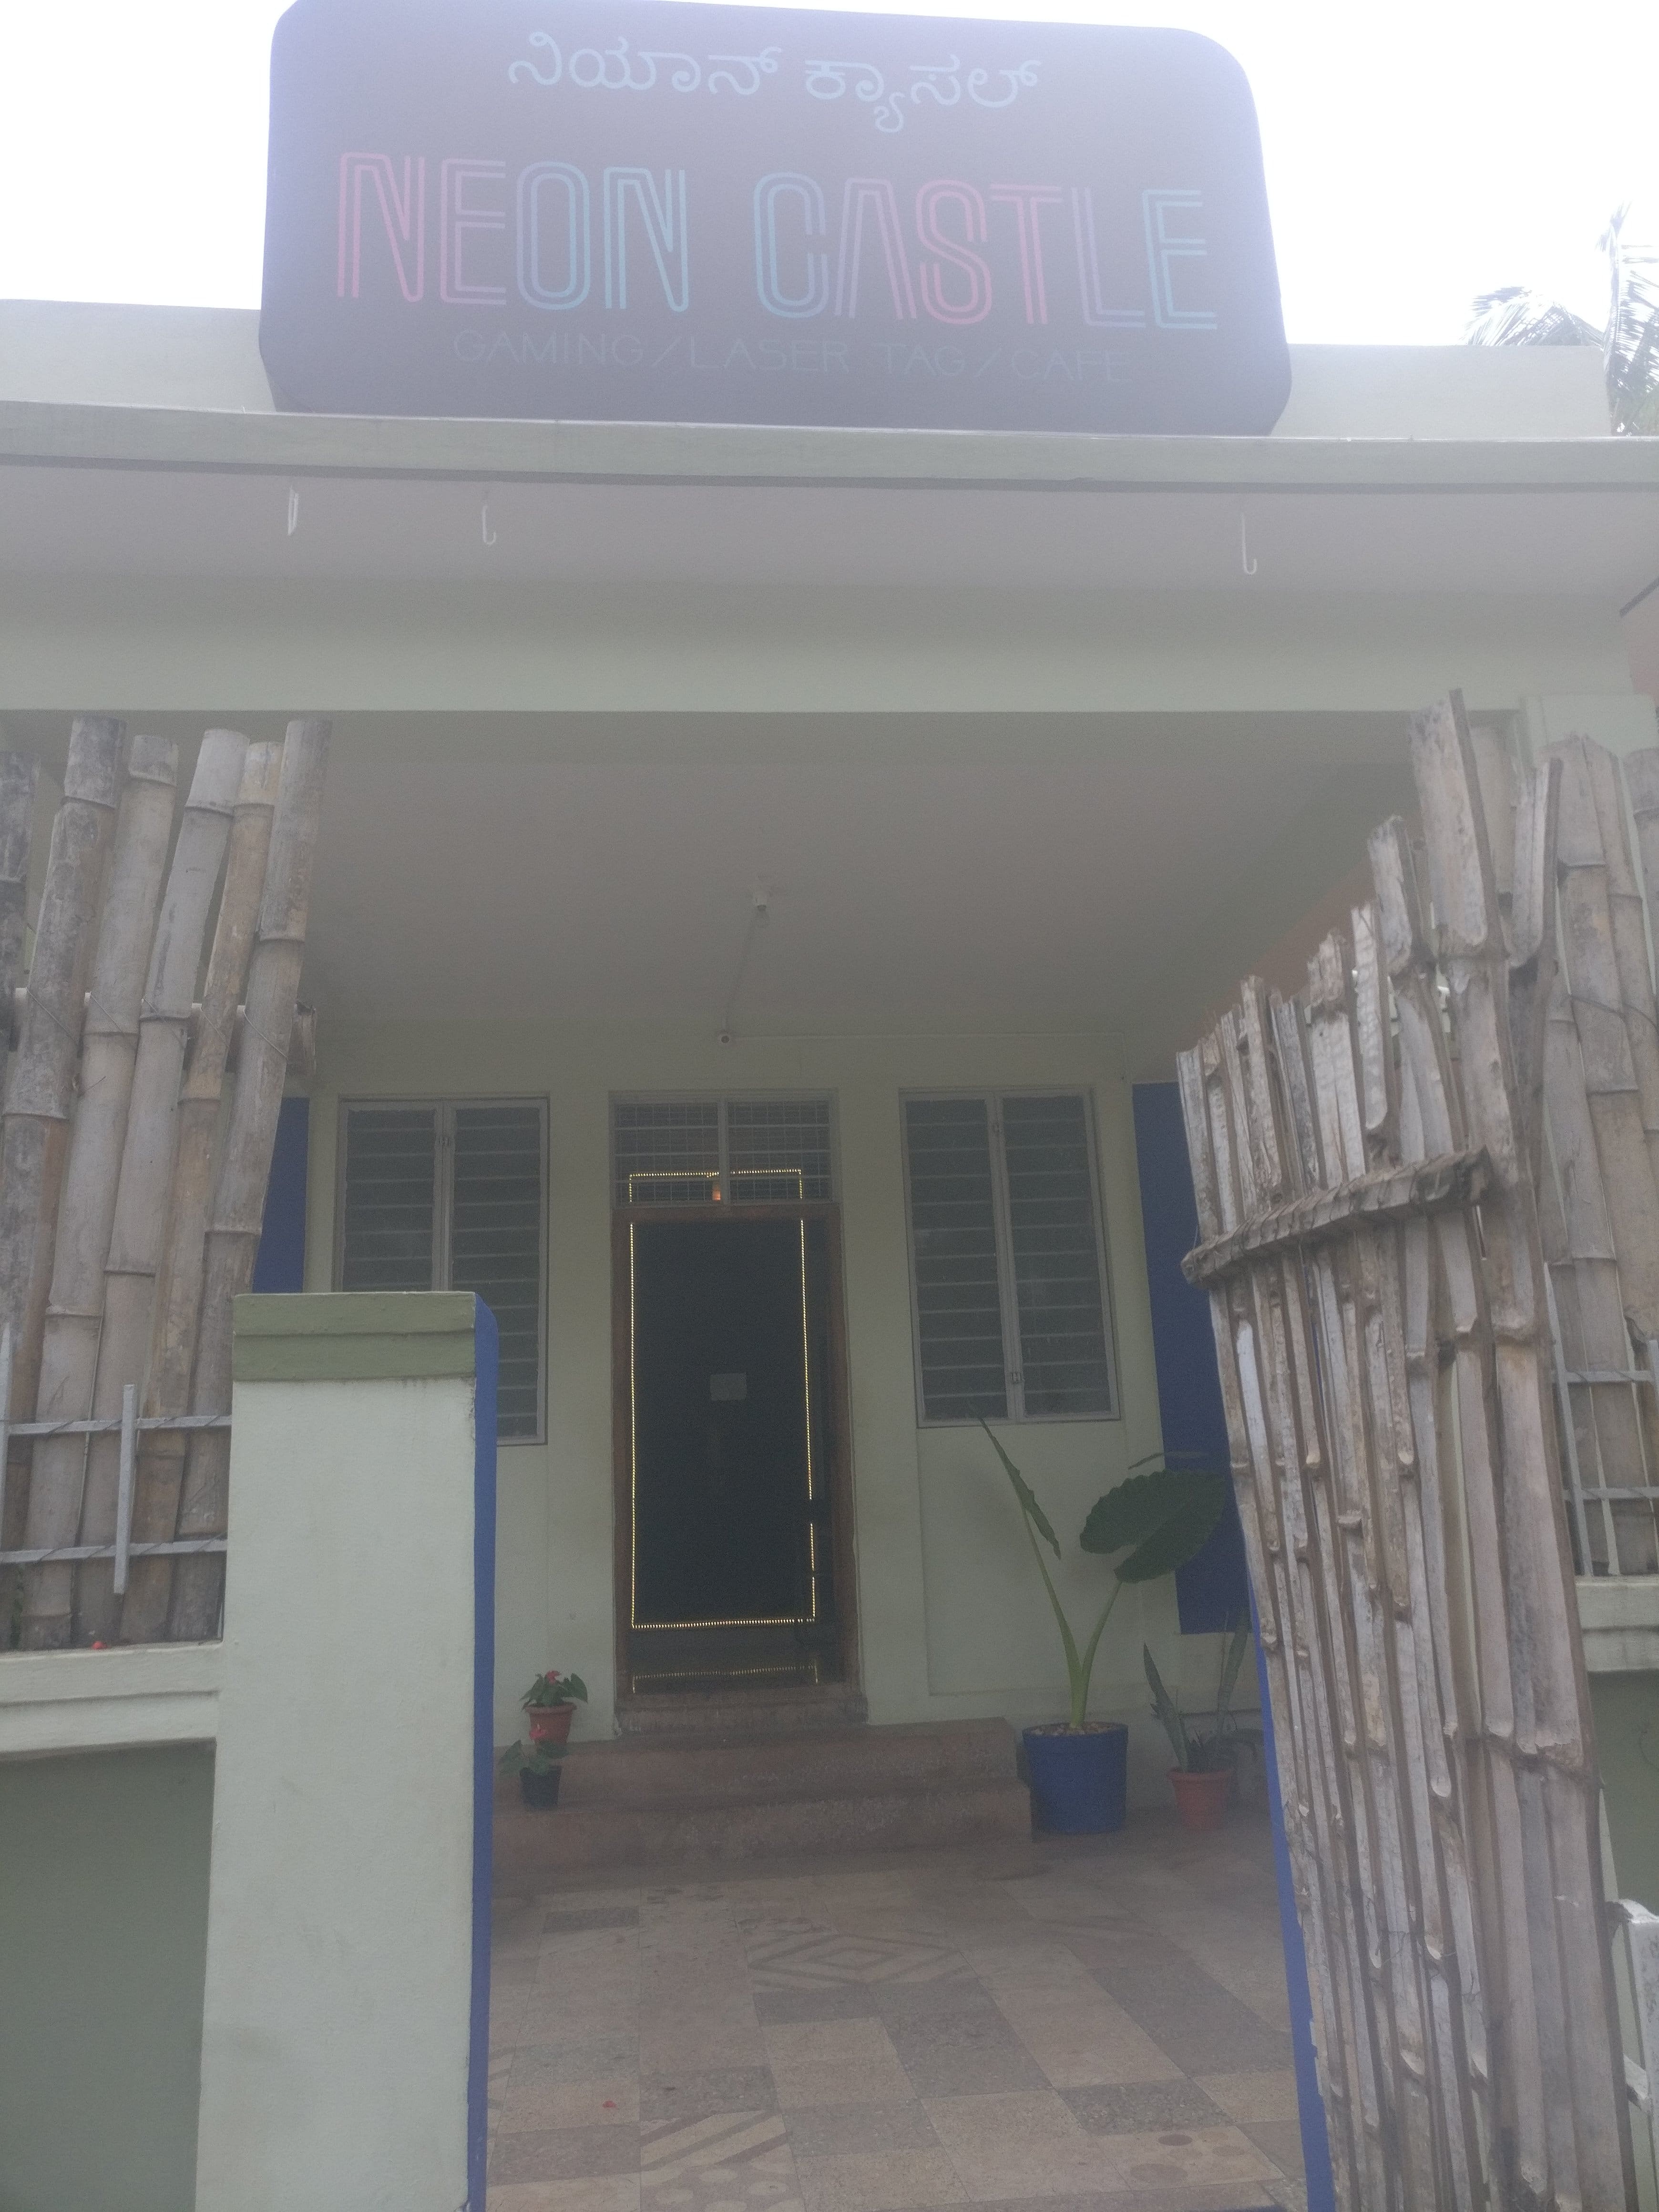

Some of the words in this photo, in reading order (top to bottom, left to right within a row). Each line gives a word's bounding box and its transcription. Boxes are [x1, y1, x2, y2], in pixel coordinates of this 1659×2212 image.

[508, 31, 783, 96] ನಿಯಾನ್
[804, 53, 1042, 133] ಕ್ಯಾಸಲ್
[337, 151, 690, 313] NEON
[753, 172, 1218, 330] CASTLE
